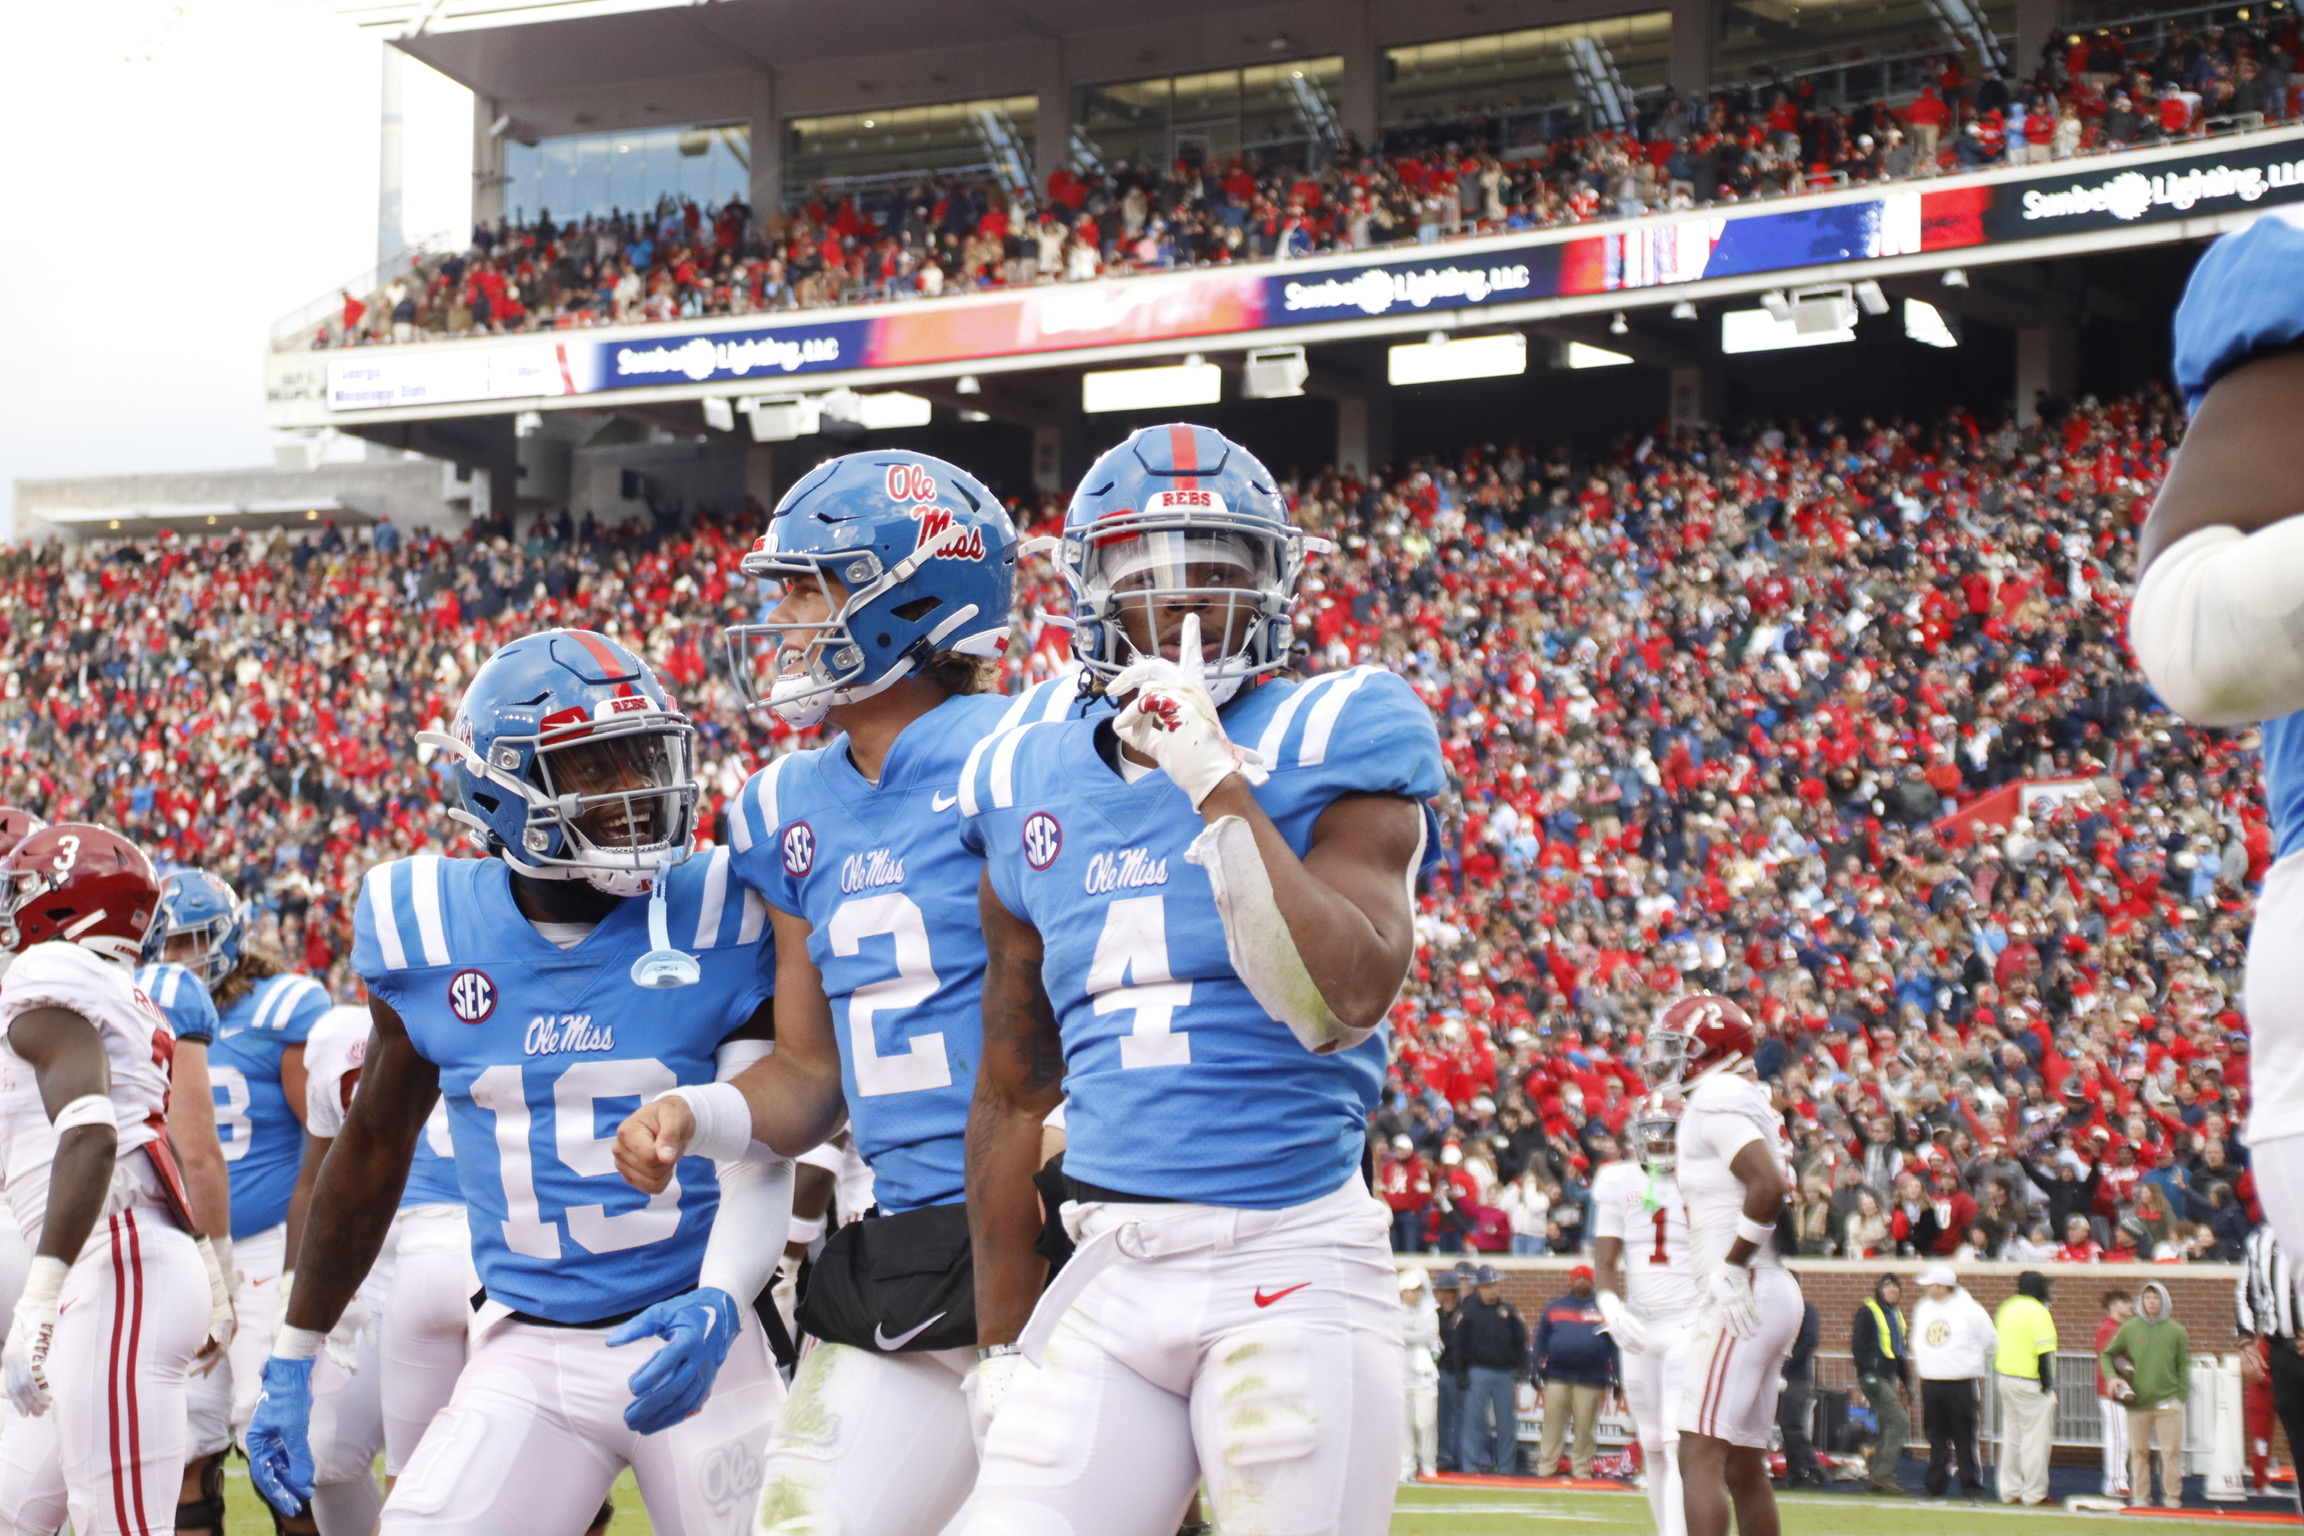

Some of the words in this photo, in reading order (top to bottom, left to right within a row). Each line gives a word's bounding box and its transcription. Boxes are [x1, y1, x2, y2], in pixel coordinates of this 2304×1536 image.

[1490, 265, 1530, 290] LLC
[803, 337, 840, 362] LLC
[888, 464, 937, 502] Ole
[1162, 491, 1211, 507] REBS
[611, 697, 649, 713] REBS
[53, 836, 80, 871] 3
[783, 826, 813, 873] SEC
[1025, 815, 1058, 866] SEC
[840, 853, 866, 894] Ole
[864, 848, 906, 888] Miss
[1085, 852, 1117, 895] Ole
[1116, 847, 1169, 890] Miss
[451, 972, 492, 1020] SEC
[828, 892, 953, 1098] 2
[1086, 894, 1193, 1070] 4
[524, 1015, 560, 1056] Ole
[560, 1014, 617, 1054] Miss
[1705, 1002, 1725, 1030] 2
[470, 1058, 682, 1259] 19
[1649, 1207, 1671, 1266] 1
[1927, 1321, 1951, 1347] SEC
[701, 1442, 759, 1503] Ole
